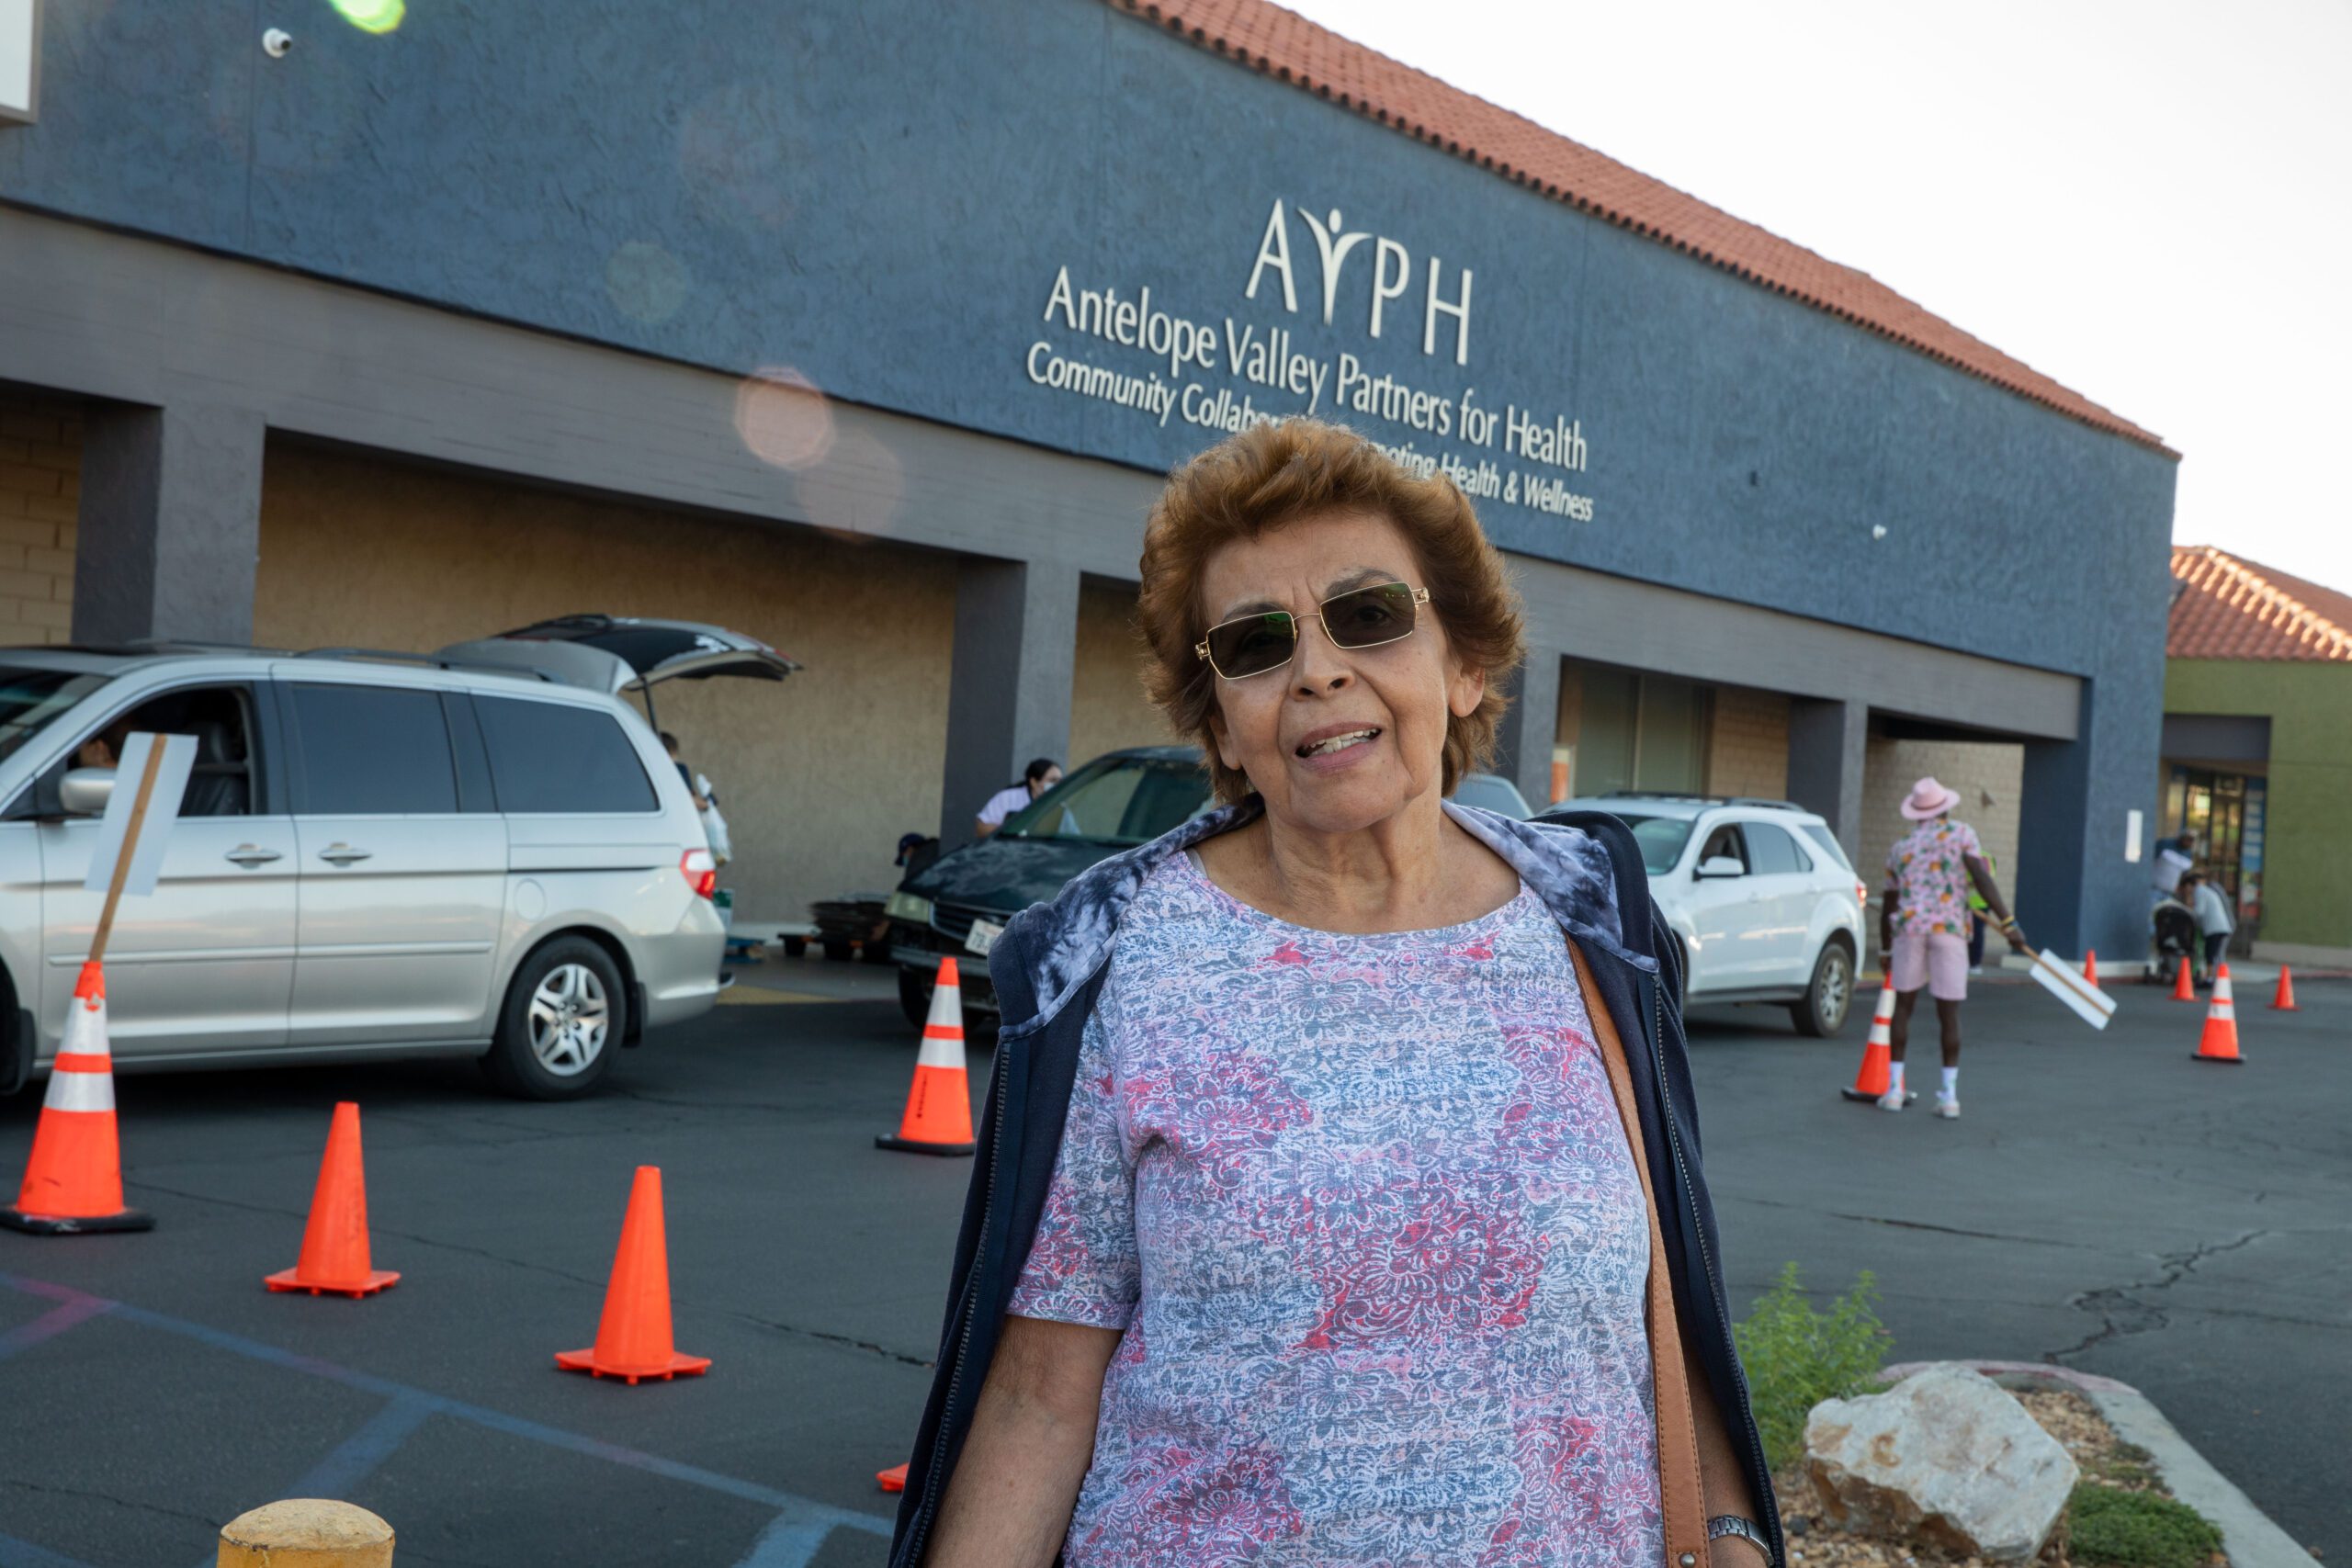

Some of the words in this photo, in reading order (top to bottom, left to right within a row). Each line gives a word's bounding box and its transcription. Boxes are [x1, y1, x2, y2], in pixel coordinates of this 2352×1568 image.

[1027, 342, 1178, 427] Community
[1442, 453, 1501, 500] Health
[1503, 471, 1520, 504] &
[1523, 474, 1594, 522] Wellness
[1044, 265, 1217, 378] Antelope
[1225, 318, 1329, 415] Valley
[1337, 353, 1452, 436] Partners
[1460, 388, 1498, 447] for
[1506, 404, 1588, 472] Health
